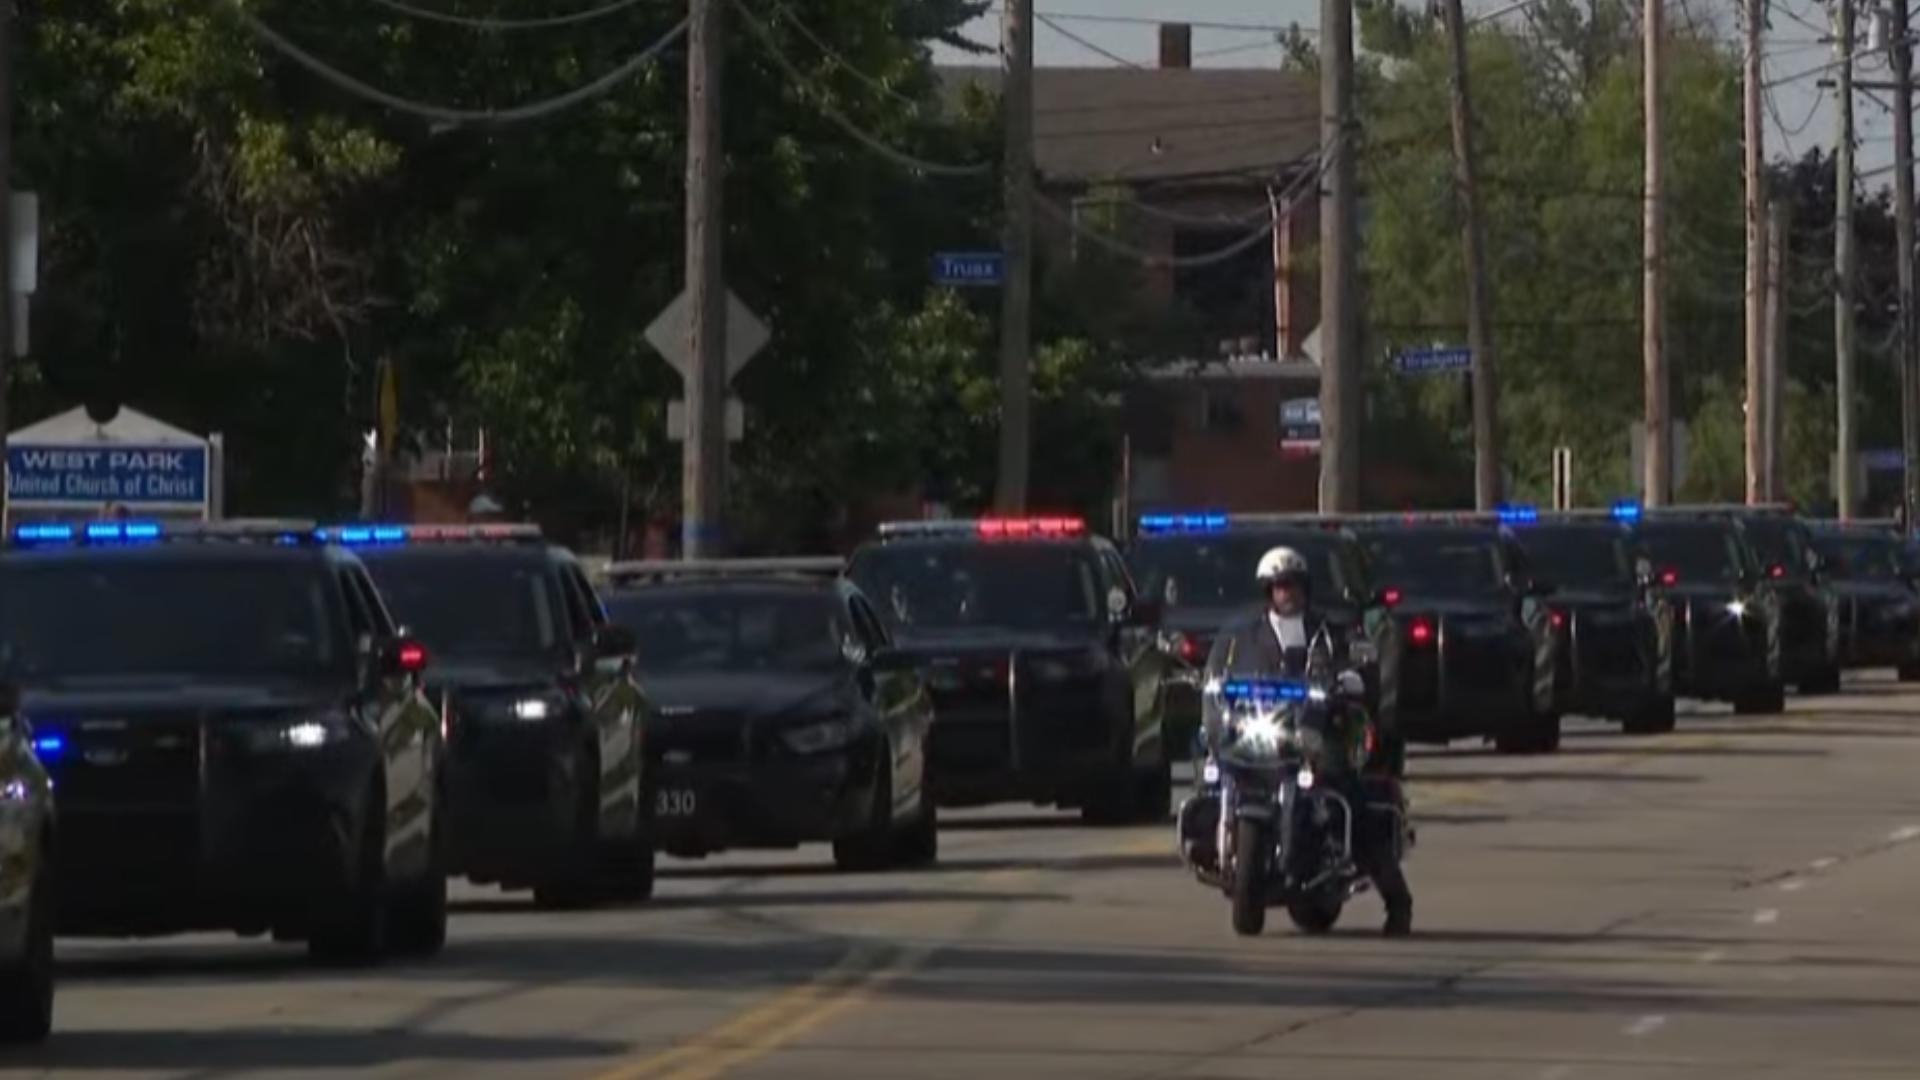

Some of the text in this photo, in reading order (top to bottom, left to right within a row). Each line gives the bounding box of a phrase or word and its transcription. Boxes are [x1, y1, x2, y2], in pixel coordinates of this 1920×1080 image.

[943, 259, 995, 277] Truax
[22, 452, 184, 470] WEST PARK
[9, 474, 195, 495] United Church of Christ
[656, 789, 696, 815] 330
